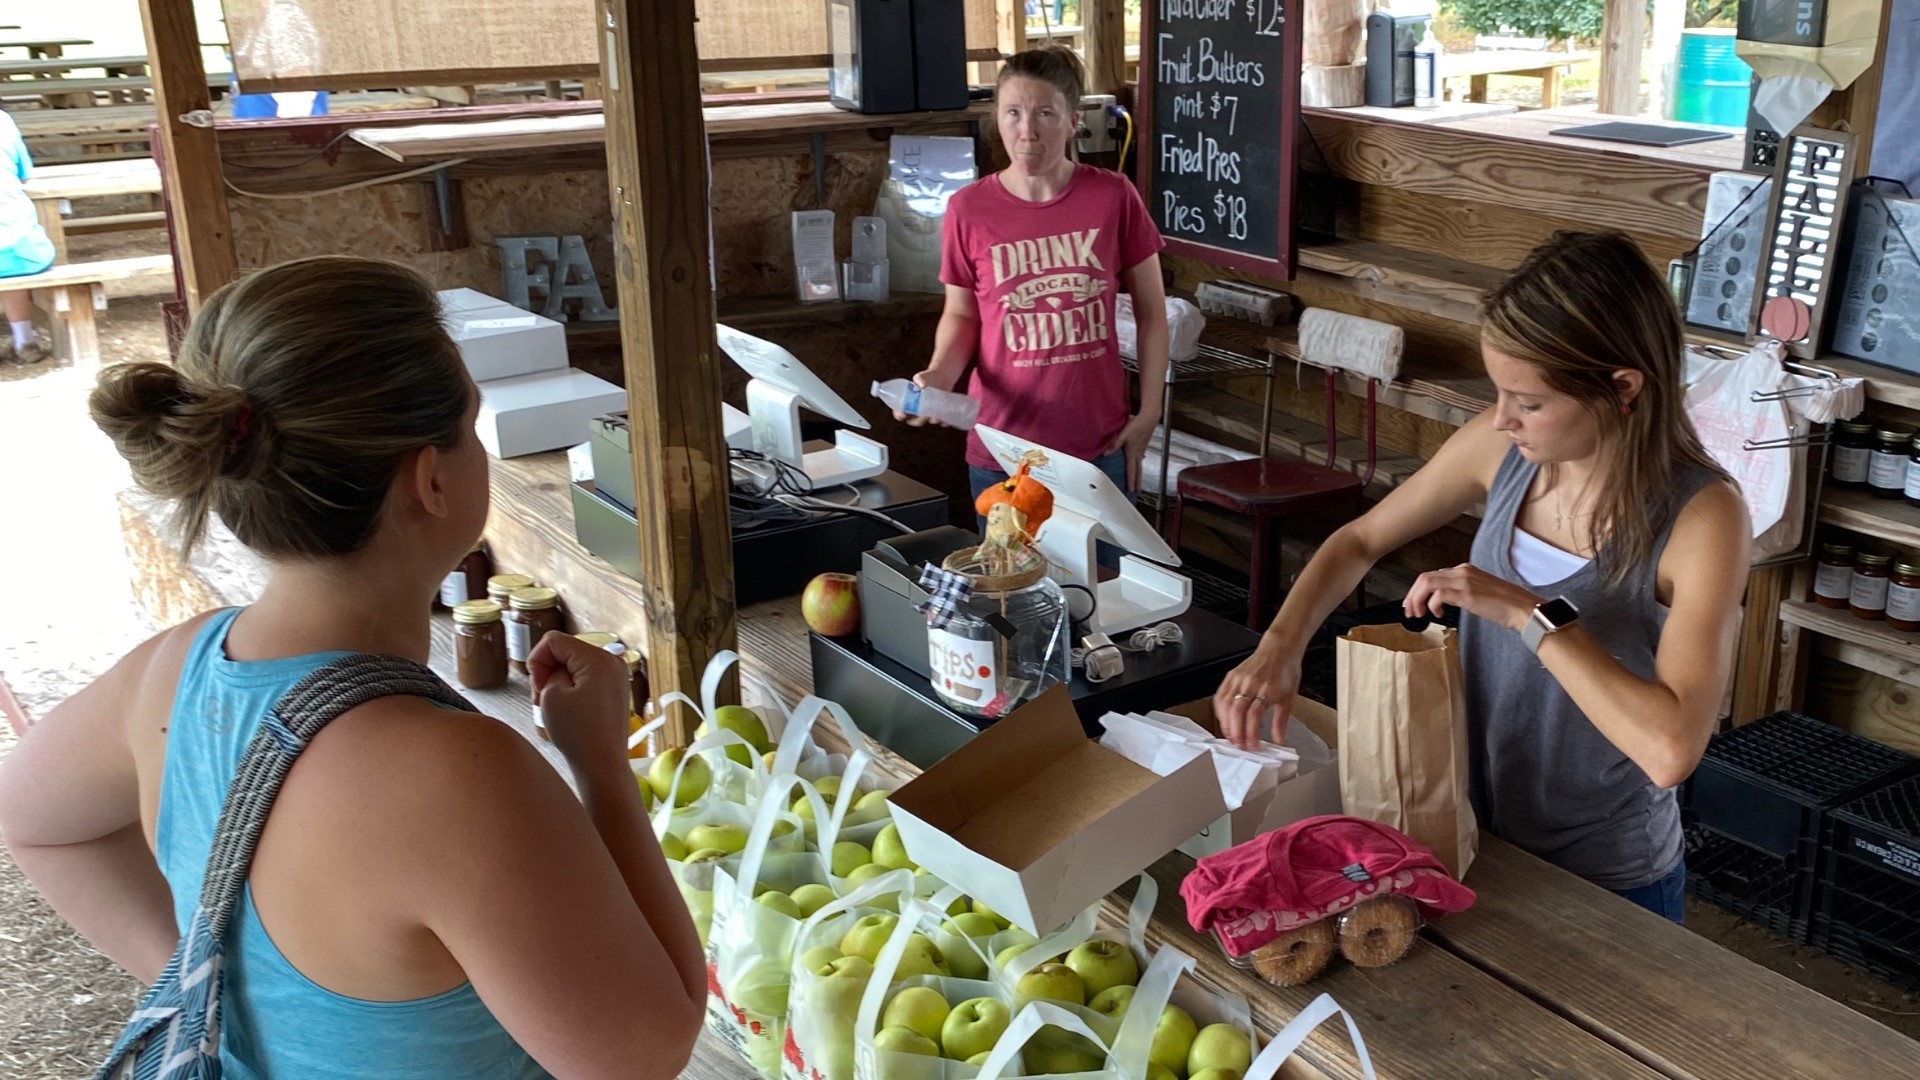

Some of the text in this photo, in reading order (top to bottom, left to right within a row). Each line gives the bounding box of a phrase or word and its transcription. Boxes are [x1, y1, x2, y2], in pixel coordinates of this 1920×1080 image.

[1158, 33, 1265, 87] Fruit Butters
[1174, 90, 1239, 136] pint $7
[1161, 131, 1241, 185] Fried Pies
[1162, 189, 1248, 241] Pies $18
[989, 228, 1107, 289] DRINK
[1024, 275, 1084, 297] LOCAL
[1004, 299, 1109, 353] CIDER
